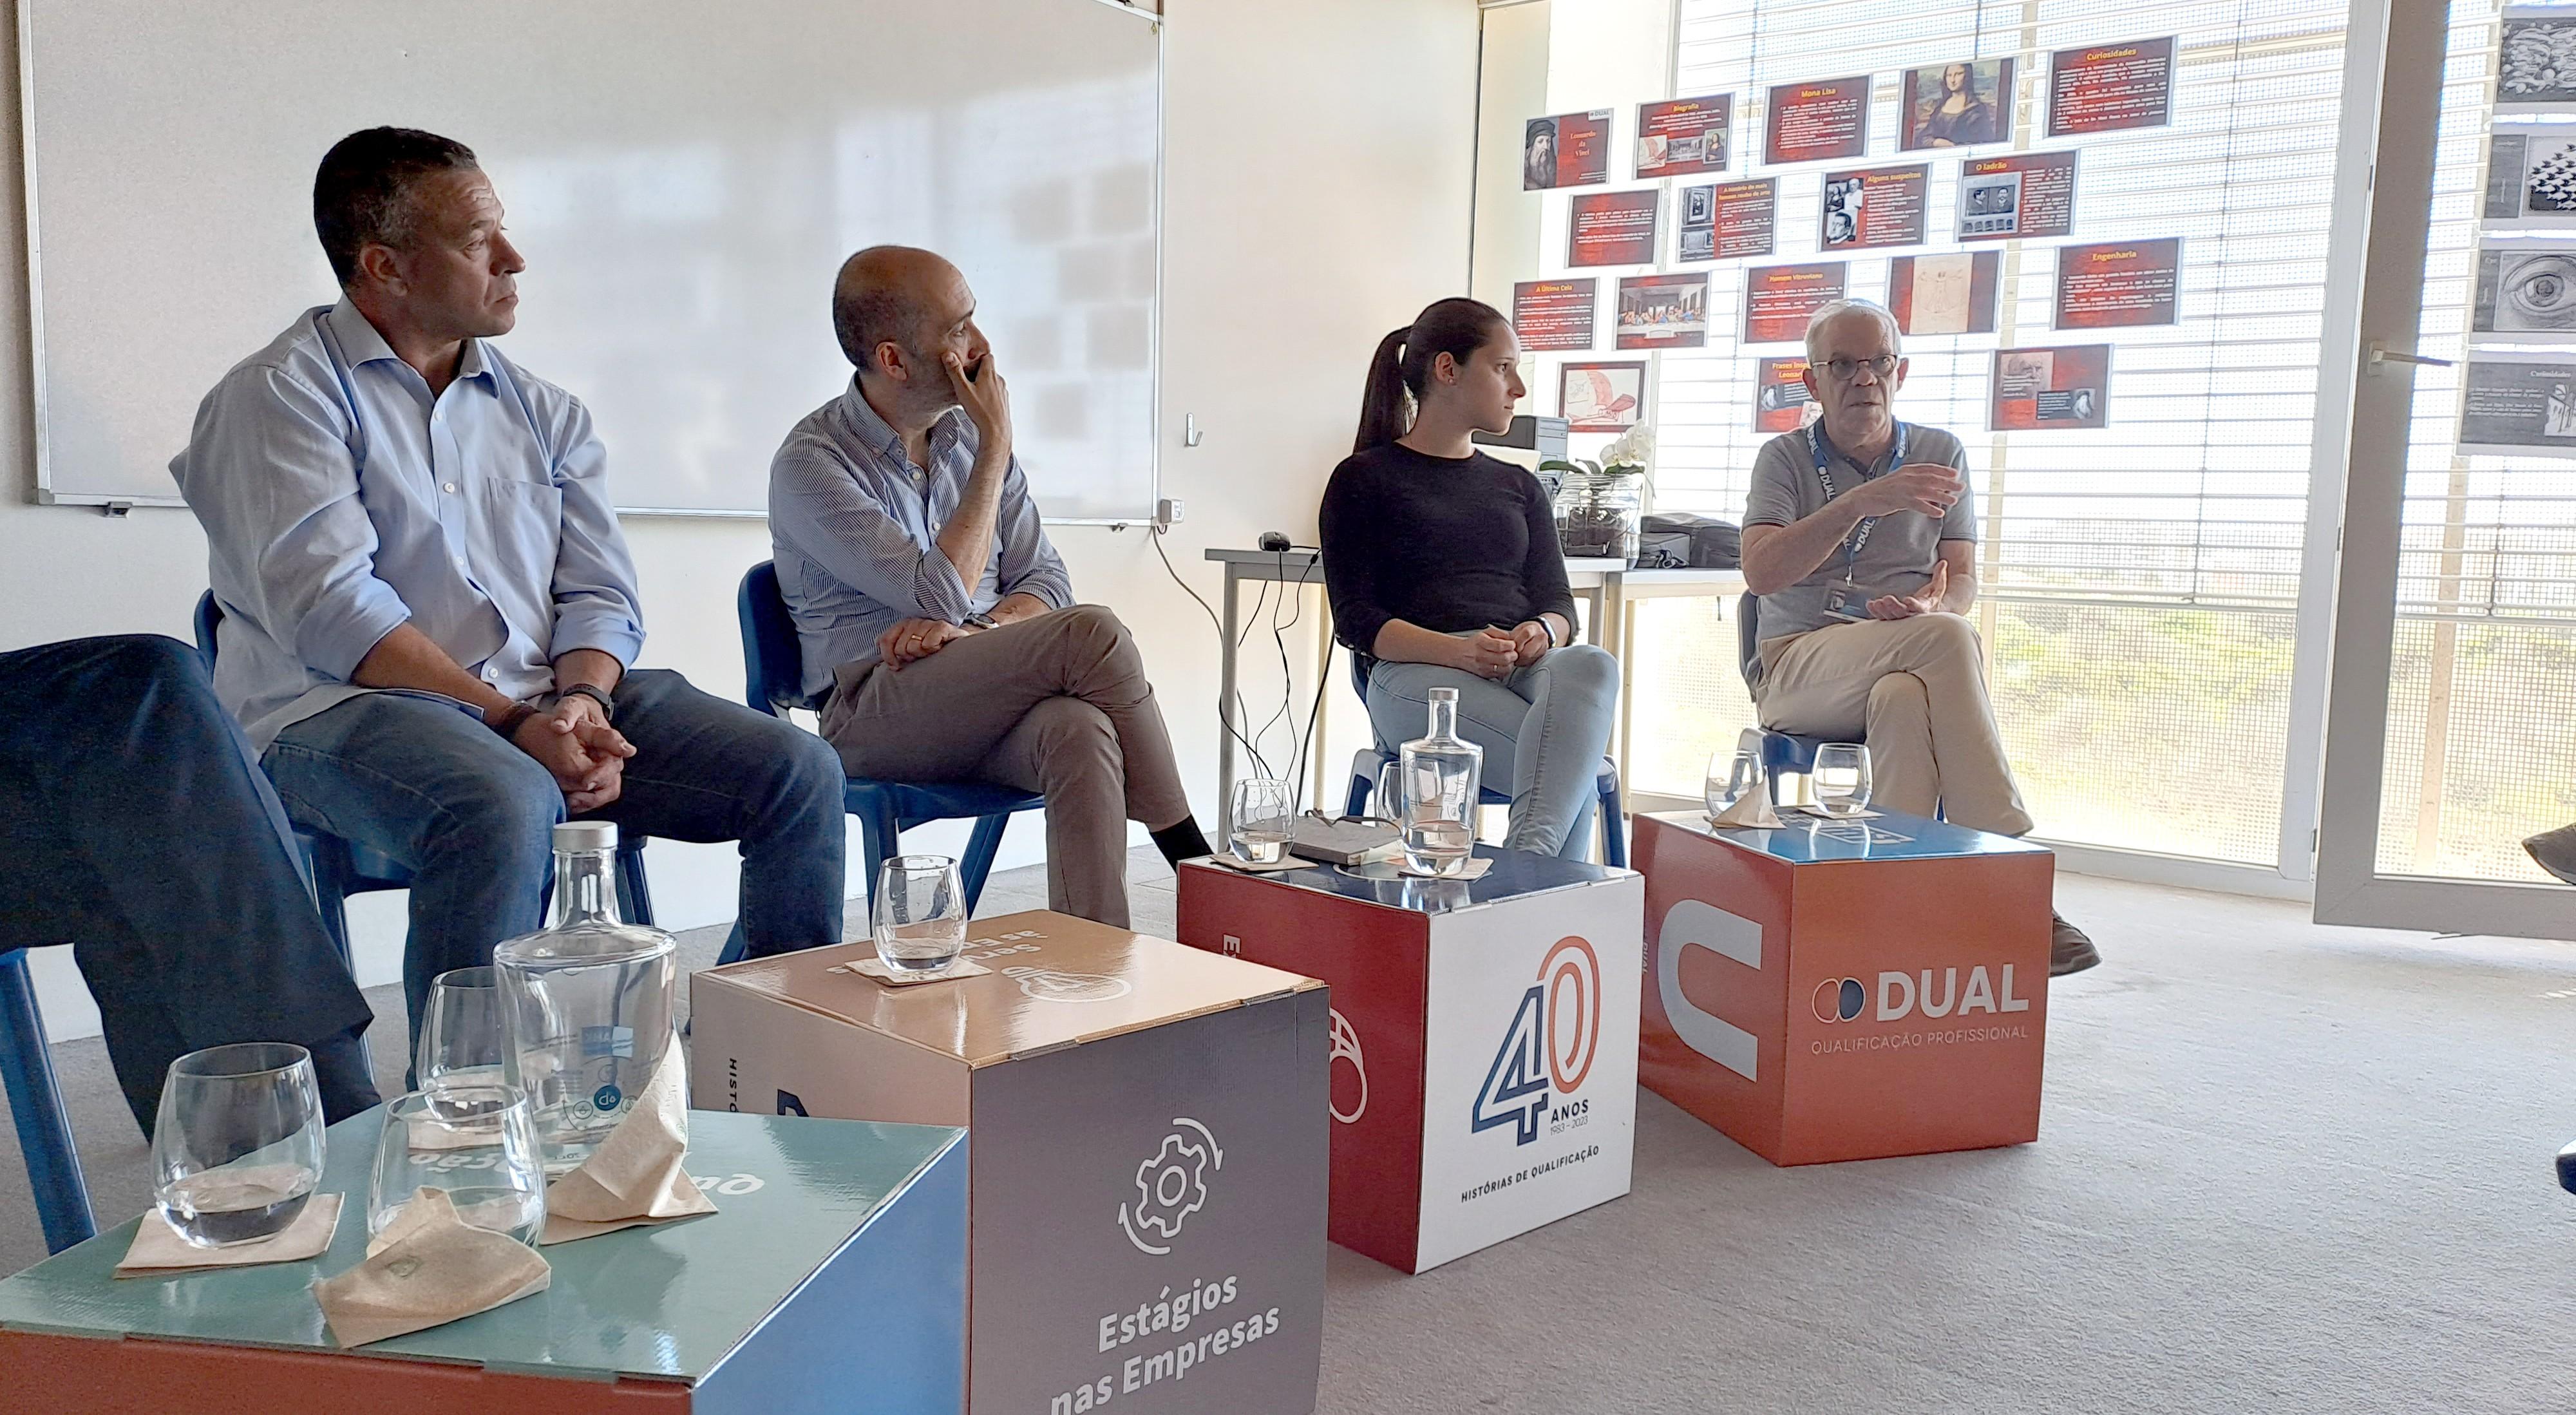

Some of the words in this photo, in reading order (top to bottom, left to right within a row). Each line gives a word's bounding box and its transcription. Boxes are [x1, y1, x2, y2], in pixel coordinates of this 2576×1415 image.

[2087, 48, 2137, 61] Curiosidades
[1801, 89, 1822, 98] Mona
[2092, 250, 2137, 261] Engenharia
[1820, 475, 1836, 501] DUAL
[1857, 519, 1876, 546] DUAL
[1876, 964, 2030, 1022] DUAL
[1471, 935, 1601, 1147] 40
[1811, 1030, 1923, 1056] QUALIFICAÇÃO
[1927, 1025, 2029, 1044] PROFISSIONAL
[730, 1058, 739, 1113] HISTÓ
[1551, 1099, 1589, 1124] ANOS
[1461, 1175, 1513, 1203] HISTÓRIAS
[1515, 1170, 1529, 1184] DE
[1531, 1145, 1599, 1179] QUALIFICAÇÃO
[1098, 1271, 1238, 1354] Estágios
[1050, 1377, 1113, 1415] nas
[1122, 1305, 1281, 1396] Empresas
